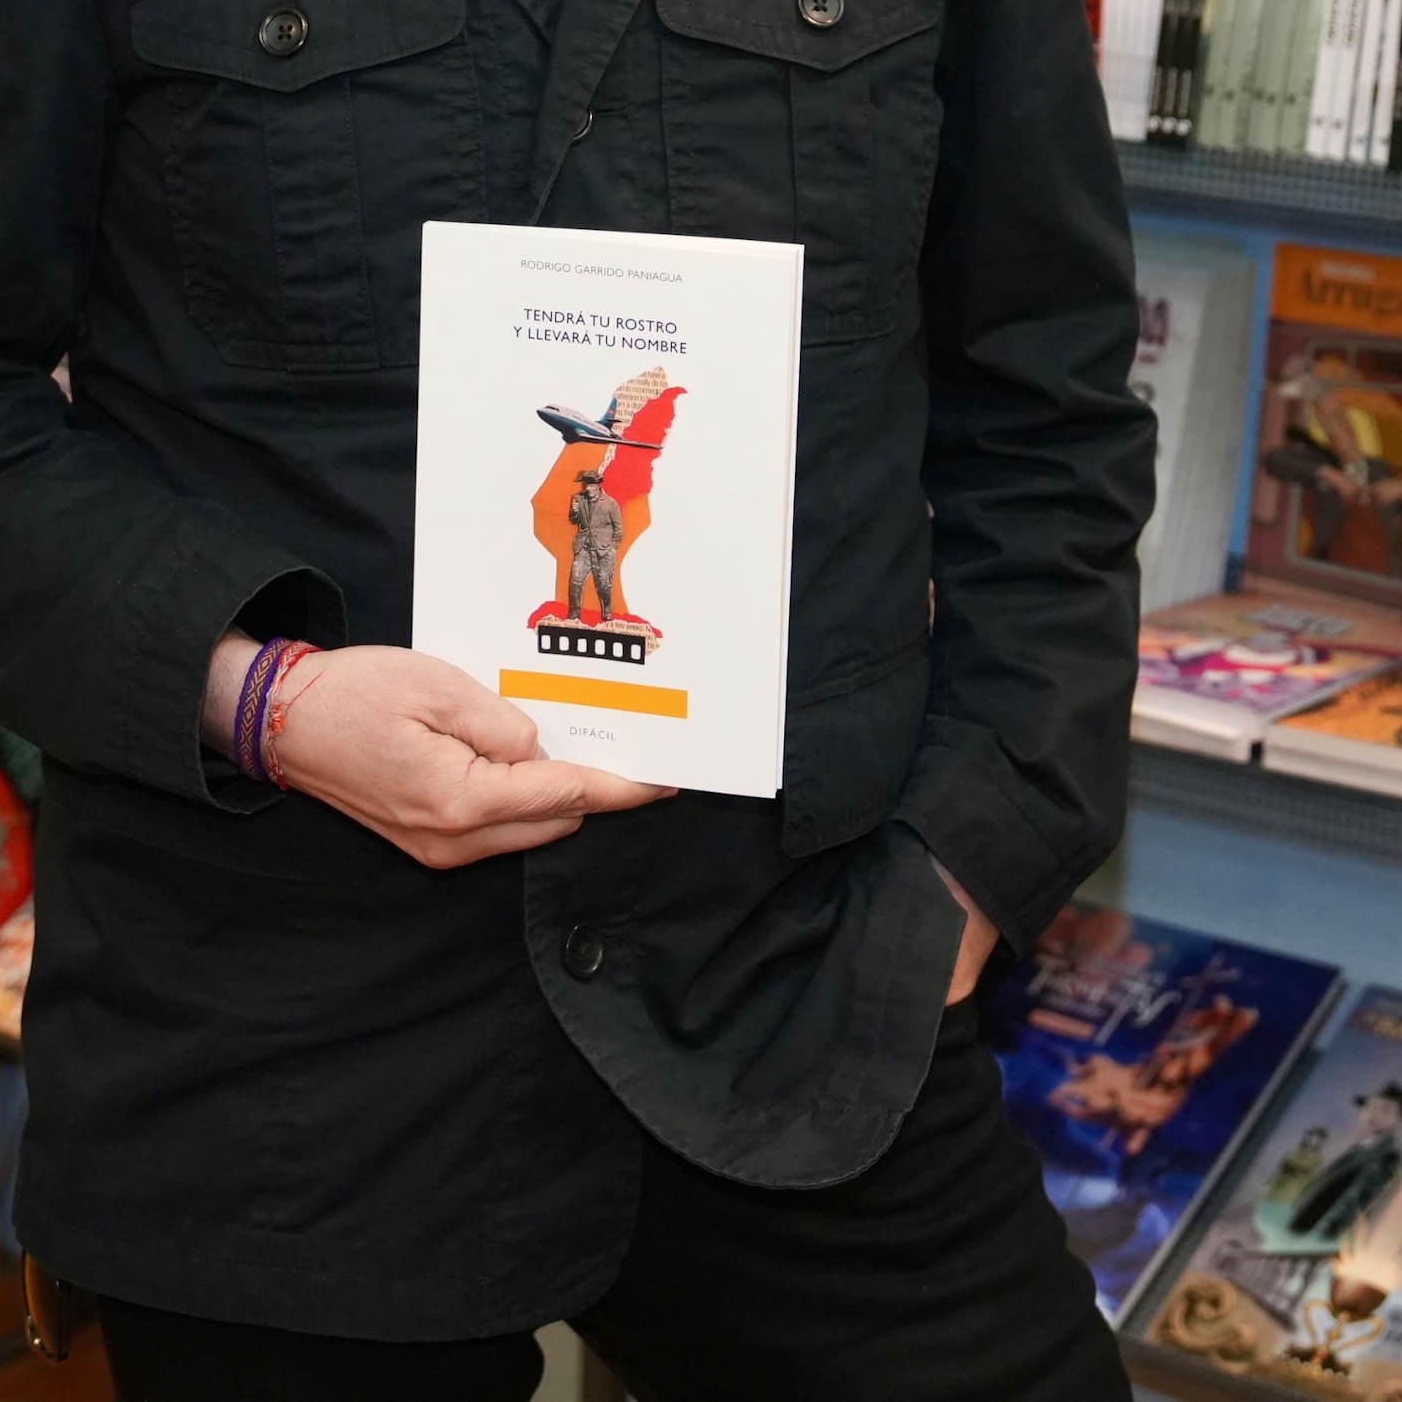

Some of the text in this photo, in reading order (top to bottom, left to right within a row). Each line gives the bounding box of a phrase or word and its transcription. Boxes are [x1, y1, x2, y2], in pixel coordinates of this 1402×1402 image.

[520, 259, 684, 283] RODRIGO GARRIDO PANIAGUA
[523, 308, 677, 334] TENDRÁ TU ROSTRO
[513, 326, 687, 355] Y LLEVARÁ TU NOMBRE
[569, 725, 617, 741] DIFÁCIL
